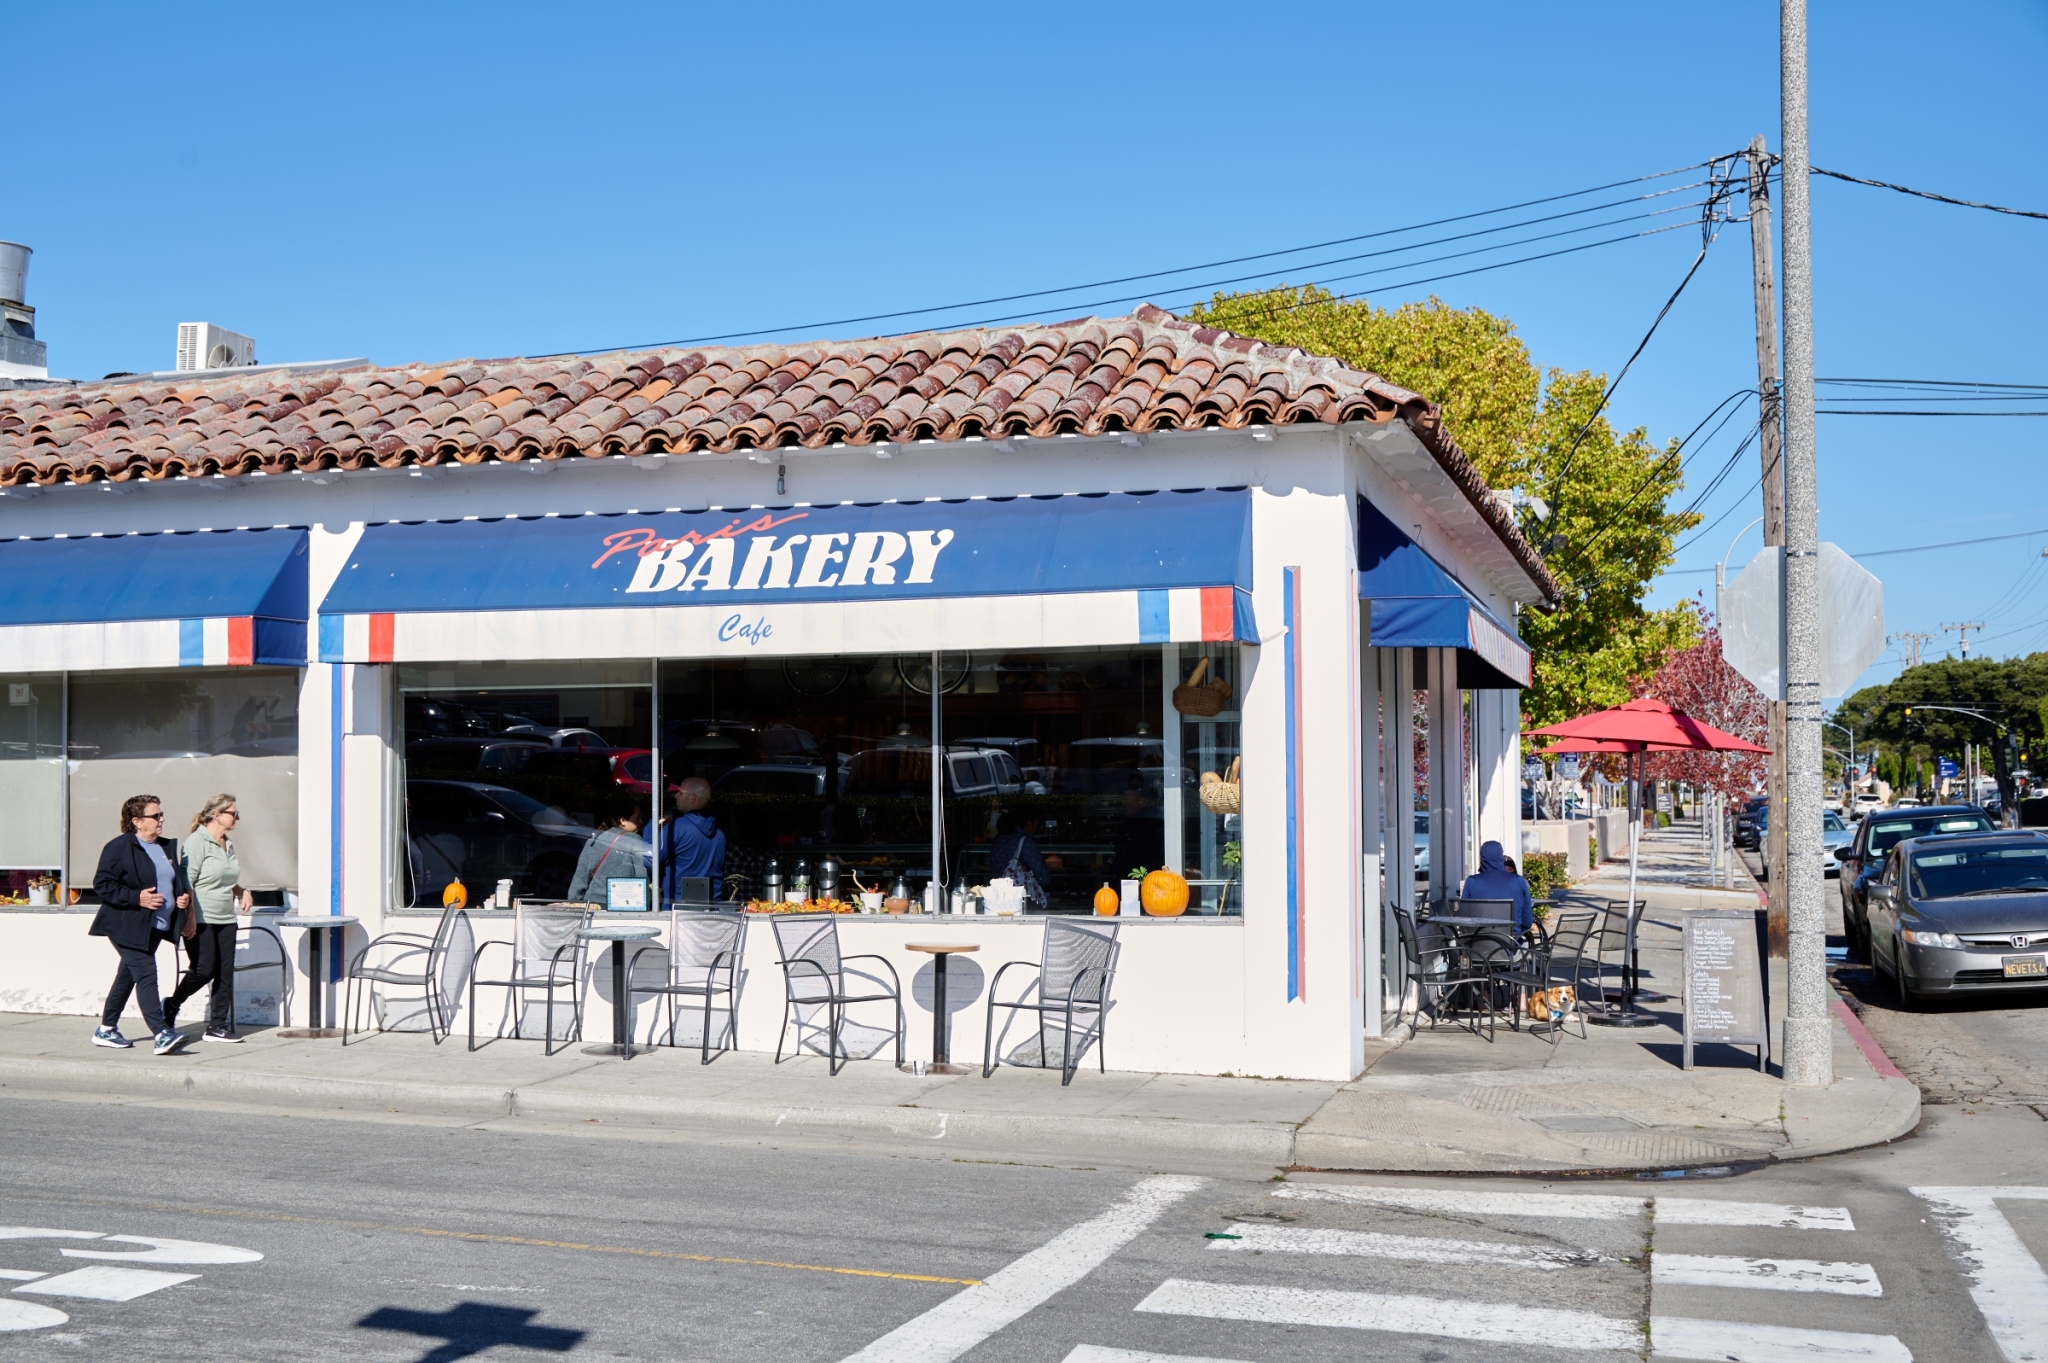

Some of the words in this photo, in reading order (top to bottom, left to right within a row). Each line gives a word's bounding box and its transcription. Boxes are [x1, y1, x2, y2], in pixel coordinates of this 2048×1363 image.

[591, 513, 809, 569] Paris
[625, 528, 955, 594] BAKERY
[718, 614, 774, 646] Cafe
